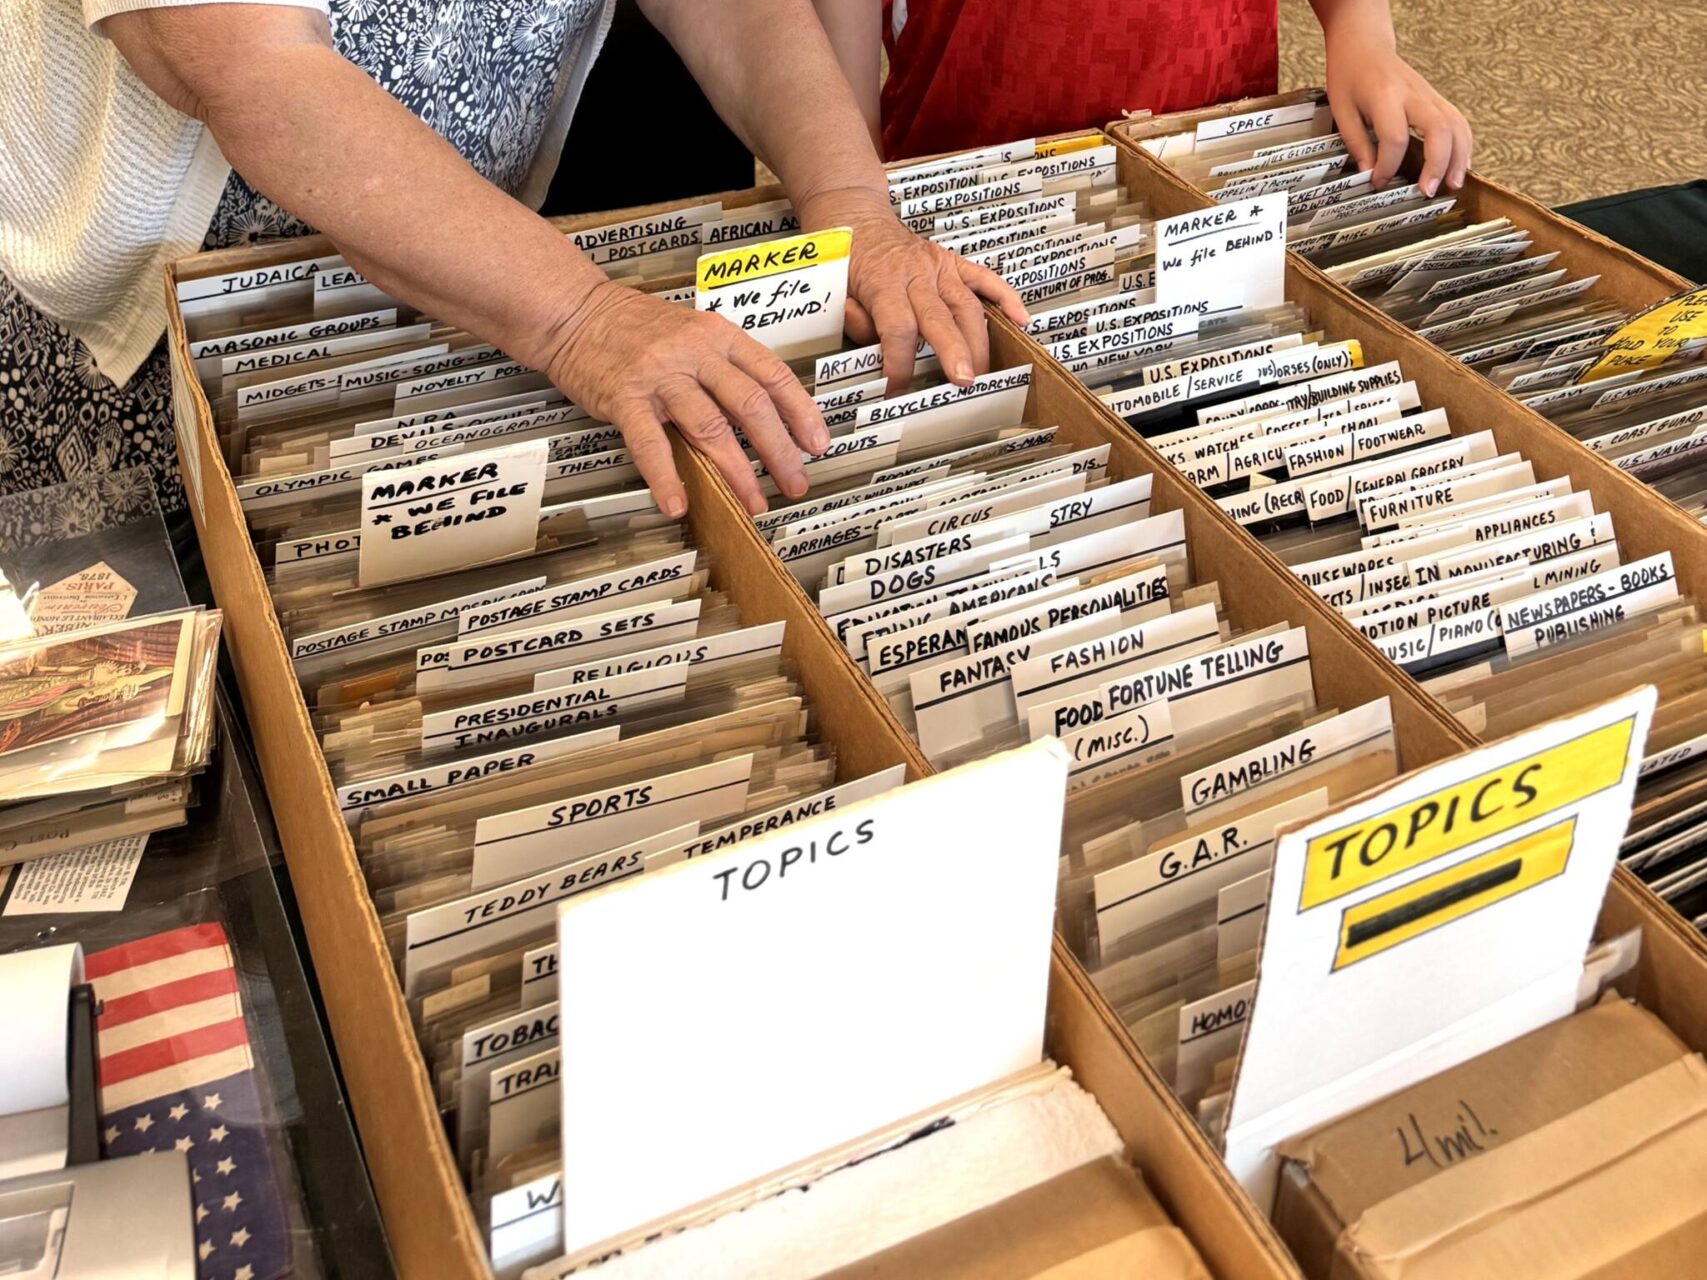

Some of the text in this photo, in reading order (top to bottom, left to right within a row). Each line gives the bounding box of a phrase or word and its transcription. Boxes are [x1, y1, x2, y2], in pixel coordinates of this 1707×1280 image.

[1226, 114, 1274, 135] SPACE
[1288, 143, 1325, 159] GLIDER
[904, 175, 978, 199] EXPOSITION
[908, 204, 932, 214] U.S.
[935, 183, 1020, 210] EXPOSITIONS
[1324, 180, 1352, 194] MAIL
[710, 220, 773, 242] AFRICAN
[908, 217, 935, 232] 1904
[944, 219, 974, 232] U.S.
[980, 198, 1065, 225] EXPOSITIONS
[1164, 210, 1238, 238] MARKER
[573, 216, 687, 249] ADVERTISING
[961, 226, 1047, 256] EXPOSITIONS
[704, 241, 818, 282] MARKER
[1006, 257, 1086, 288] EXPOSITIONS
[1190, 247, 1216, 268] file
[222, 263, 321, 294] JUDAICA
[771, 280, 811, 306] file
[1022, 282, 1068, 303] CENTURY
[1069, 279, 1081, 288] OF
[1123, 273, 1146, 290] U.S.
[1050, 298, 1136, 331] EXPOSITIONS
[1097, 319, 1120, 332] U.S.
[1124, 301, 1209, 326] EXPOSITIONS
[1677, 295, 1707, 307] PLEA
[199, 316, 381, 358] MASONIC GROUPS
[1078, 323, 1173, 355] EXPOSITIONS
[1658, 326, 1679, 336] TO
[236, 346, 332, 371] MEDICAL
[820, 360, 848, 380] ART
[1150, 344, 1274, 383] U.S. EXPOSITIONS
[1277, 361, 1310, 377] ORSES
[411, 371, 486, 395] NOVELTY
[1358, 370, 1402, 392] SUPPLIES
[1106, 384, 1180, 412] TOMOBILE
[415, 408, 574, 449] OCEANOGRAPHY
[1611, 411, 1703, 444] COAST GUARD
[811, 435, 878, 461] COUTS
[1289, 423, 1427, 471] FASHION FOOTWEAR
[1618, 455, 1644, 469] U.S.
[558, 454, 625, 475] THEME
[1181, 465, 1219, 485] ARM
[256, 471, 353, 497] OLYMPIC
[370, 462, 499, 501] MARKER
[408, 482, 528, 518] WE FILE
[755, 506, 817, 529] BUFFALO
[822, 495, 862, 513] BILL'S
[1050, 497, 1094, 525] STRY
[1227, 492, 1304, 520] HING (RECR
[1310, 492, 1345, 510] FOOD
[1370, 488, 1454, 522] FURNITURE
[390, 505, 507, 540] BEHIND
[927, 507, 993, 536] CIRCUS
[1475, 510, 1556, 541] APPLIANCES
[293, 535, 360, 557] PHOT
[865, 534, 973, 576] DISASTERS
[62, 582, 115, 592] PARIS.
[869, 565, 937, 601] DOGS
[1369, 575, 1410, 596] INSEC
[1544, 559, 1601, 585] MINING
[467, 598, 544, 630] POSTAGE
[551, 582, 612, 610] STAMP
[618, 564, 683, 592] CARDS
[1428, 592, 1491, 624] PICTURE
[1508, 563, 1668, 628] NEWSPAPERS BOOKS
[972, 616, 1041, 654] FAMOUS
[1048, 575, 1170, 632] PERSONALITIES
[1534, 605, 1625, 645] PUBLISHING
[295, 612, 436, 658] POSTAGE STAMP
[463, 613, 656, 663] POSTCARD SETS
[1049, 630, 1145, 673] FASHION
[939, 645, 1032, 694] FANTASY
[1108, 640, 1285, 711] FORTUNE TELLING
[454, 688, 611, 729] PRESIDENTIAL
[1054, 699, 1102, 738] FOOD
[454, 703, 619, 751] INAUGURALS
[1074, 714, 1150, 760] (MISC.)
[347, 753, 536, 806] SMALL PAPER
[1190, 737, 1318, 807] GAMBLING
[548, 786, 653, 826] SPORTS
[1323, 761, 1545, 882] TOPICS
[683, 795, 837, 861] TEMPERANCE
[712, 818, 874, 902] TOPICS
[1158, 825, 1248, 880] G.A.R.
[464, 850, 644, 924] TEDDY BEARS
[472, 1014, 559, 1059] TOBAC
